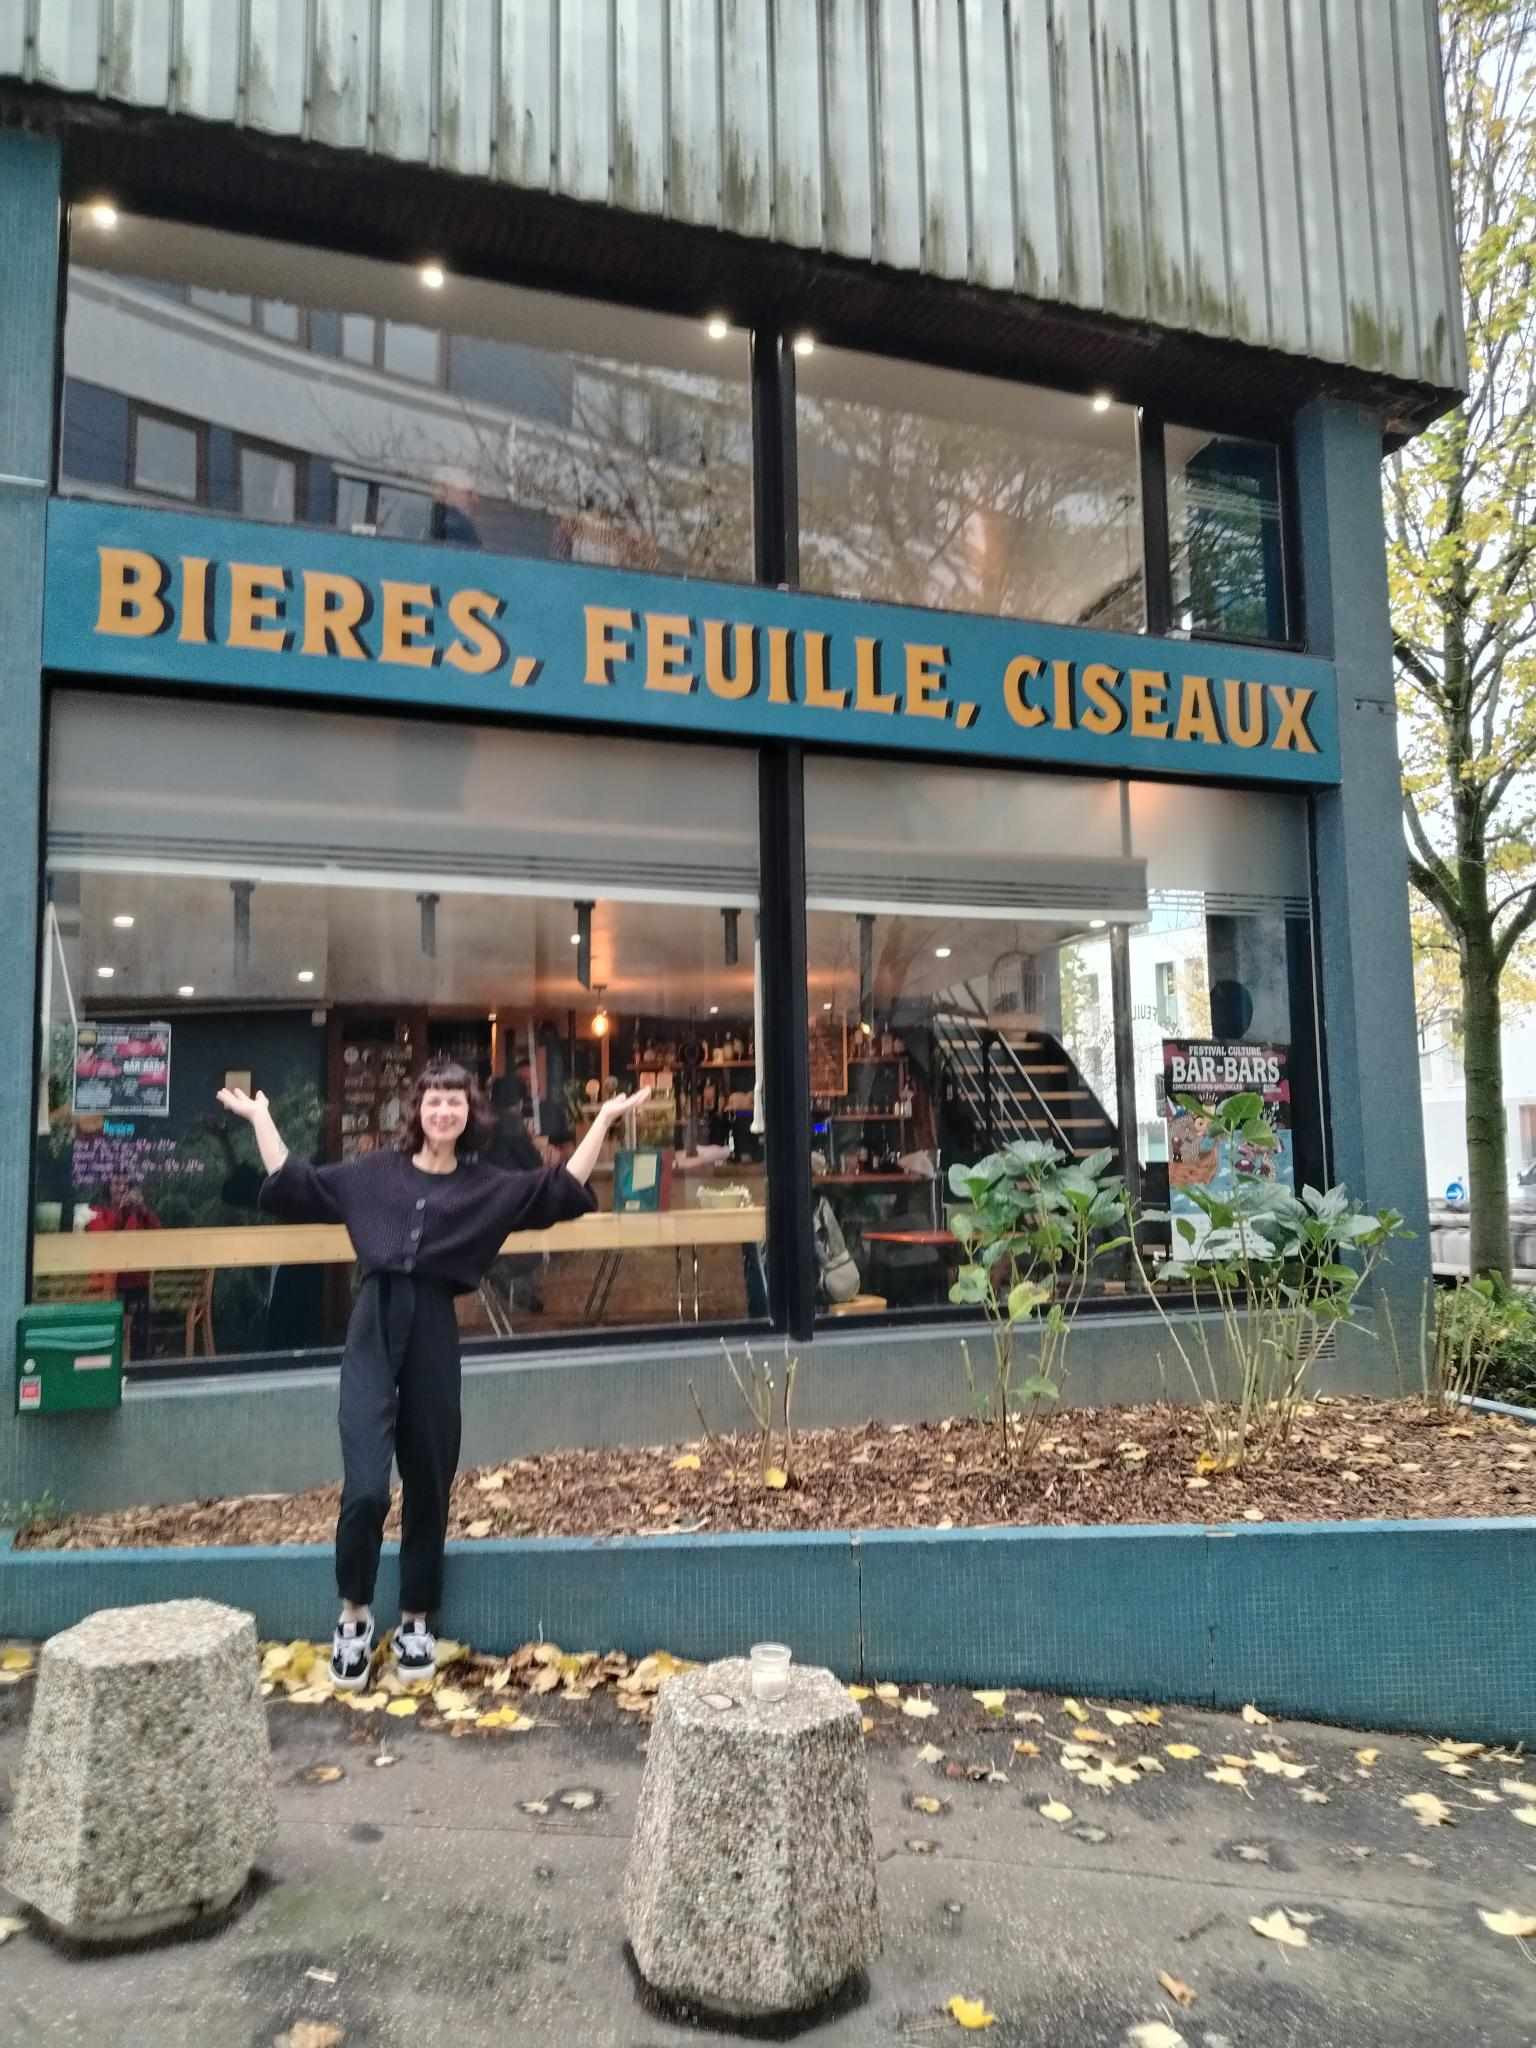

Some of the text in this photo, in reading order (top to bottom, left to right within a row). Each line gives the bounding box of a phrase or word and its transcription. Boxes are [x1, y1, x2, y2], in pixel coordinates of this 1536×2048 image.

[95, 546, 1321, 753] BIERES, FEUILLE, CISEAUX
[1188, 1046, 1262, 1057] FESTIVAL CULTURE
[1171, 1056, 1280, 1083] BAR-BARS
